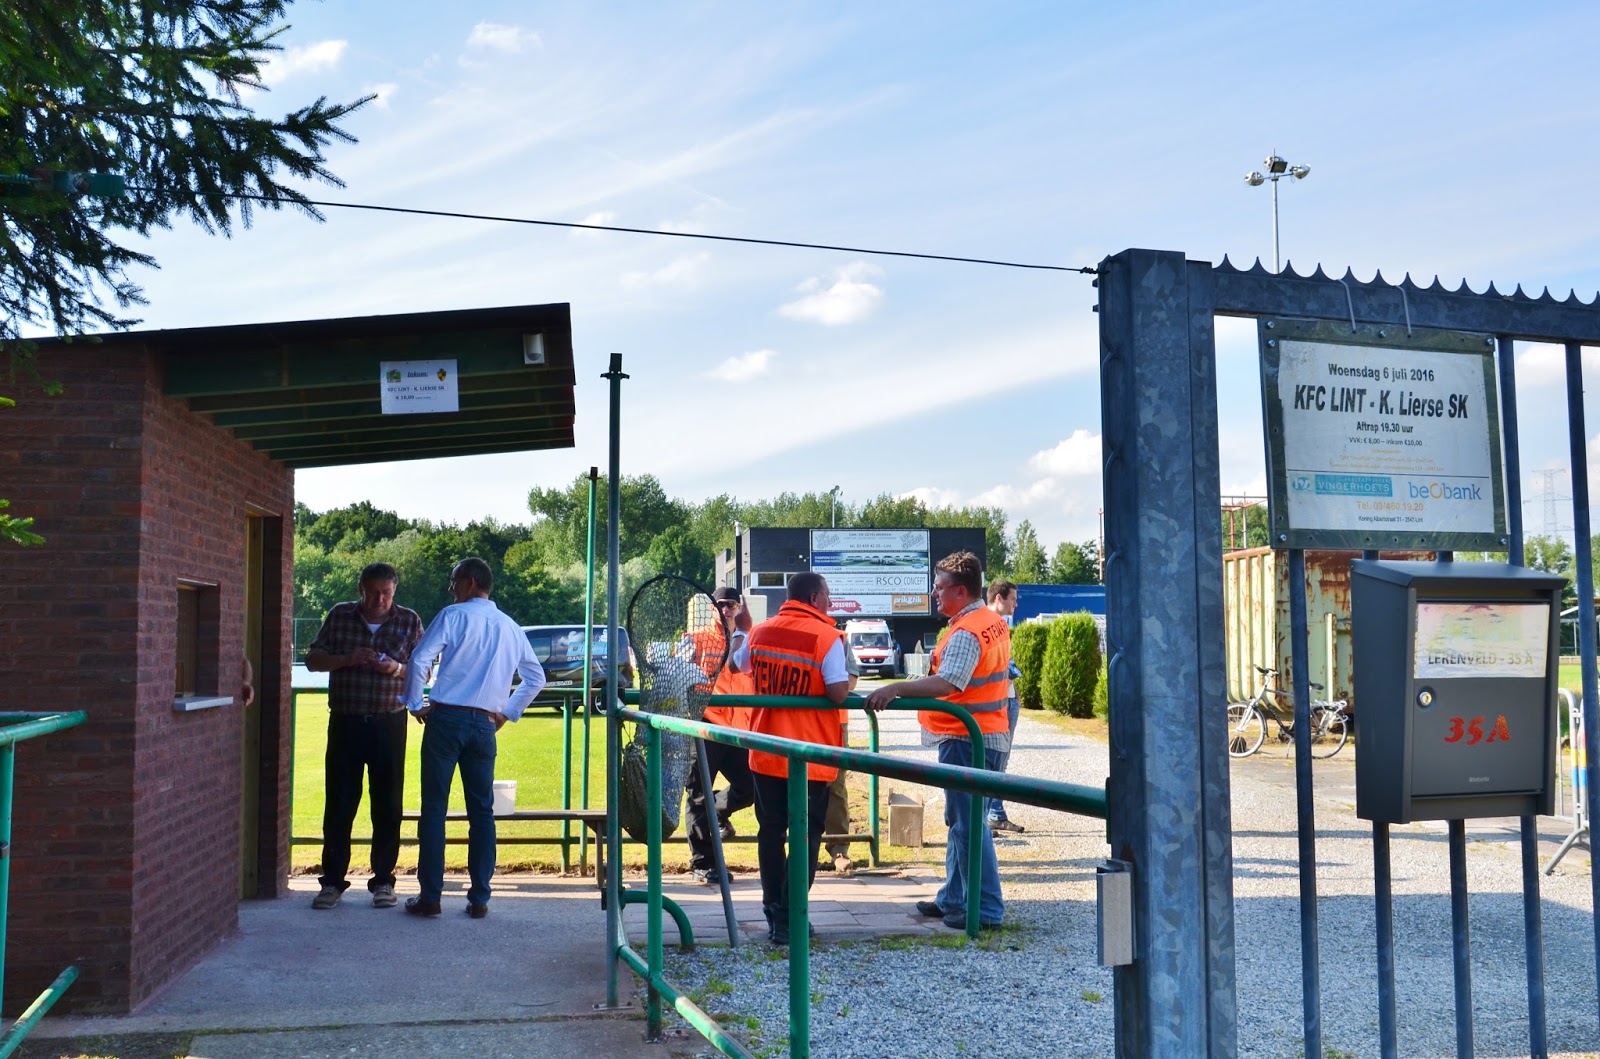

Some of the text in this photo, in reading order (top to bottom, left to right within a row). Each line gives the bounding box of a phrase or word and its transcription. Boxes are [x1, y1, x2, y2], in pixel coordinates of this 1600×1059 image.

[1328, 363, 1435, 383] Woensdag 6 juli 2016
[1294, 384, 1326, 411] KFC
[1330, 386, 1367, 413] LINT
[1379, 389, 1394, 415] K.
[1399, 391, 1444, 418] Lierse
[1448, 393, 1470, 419] SK
[1356, 421, 1414, 434] Aftrap 19.30 uur
[1317, 481, 1390, 493] VINGERHOETS
[876, 576, 902, 586] RSCO
[903, 576, 926, 586] CONCEPT
